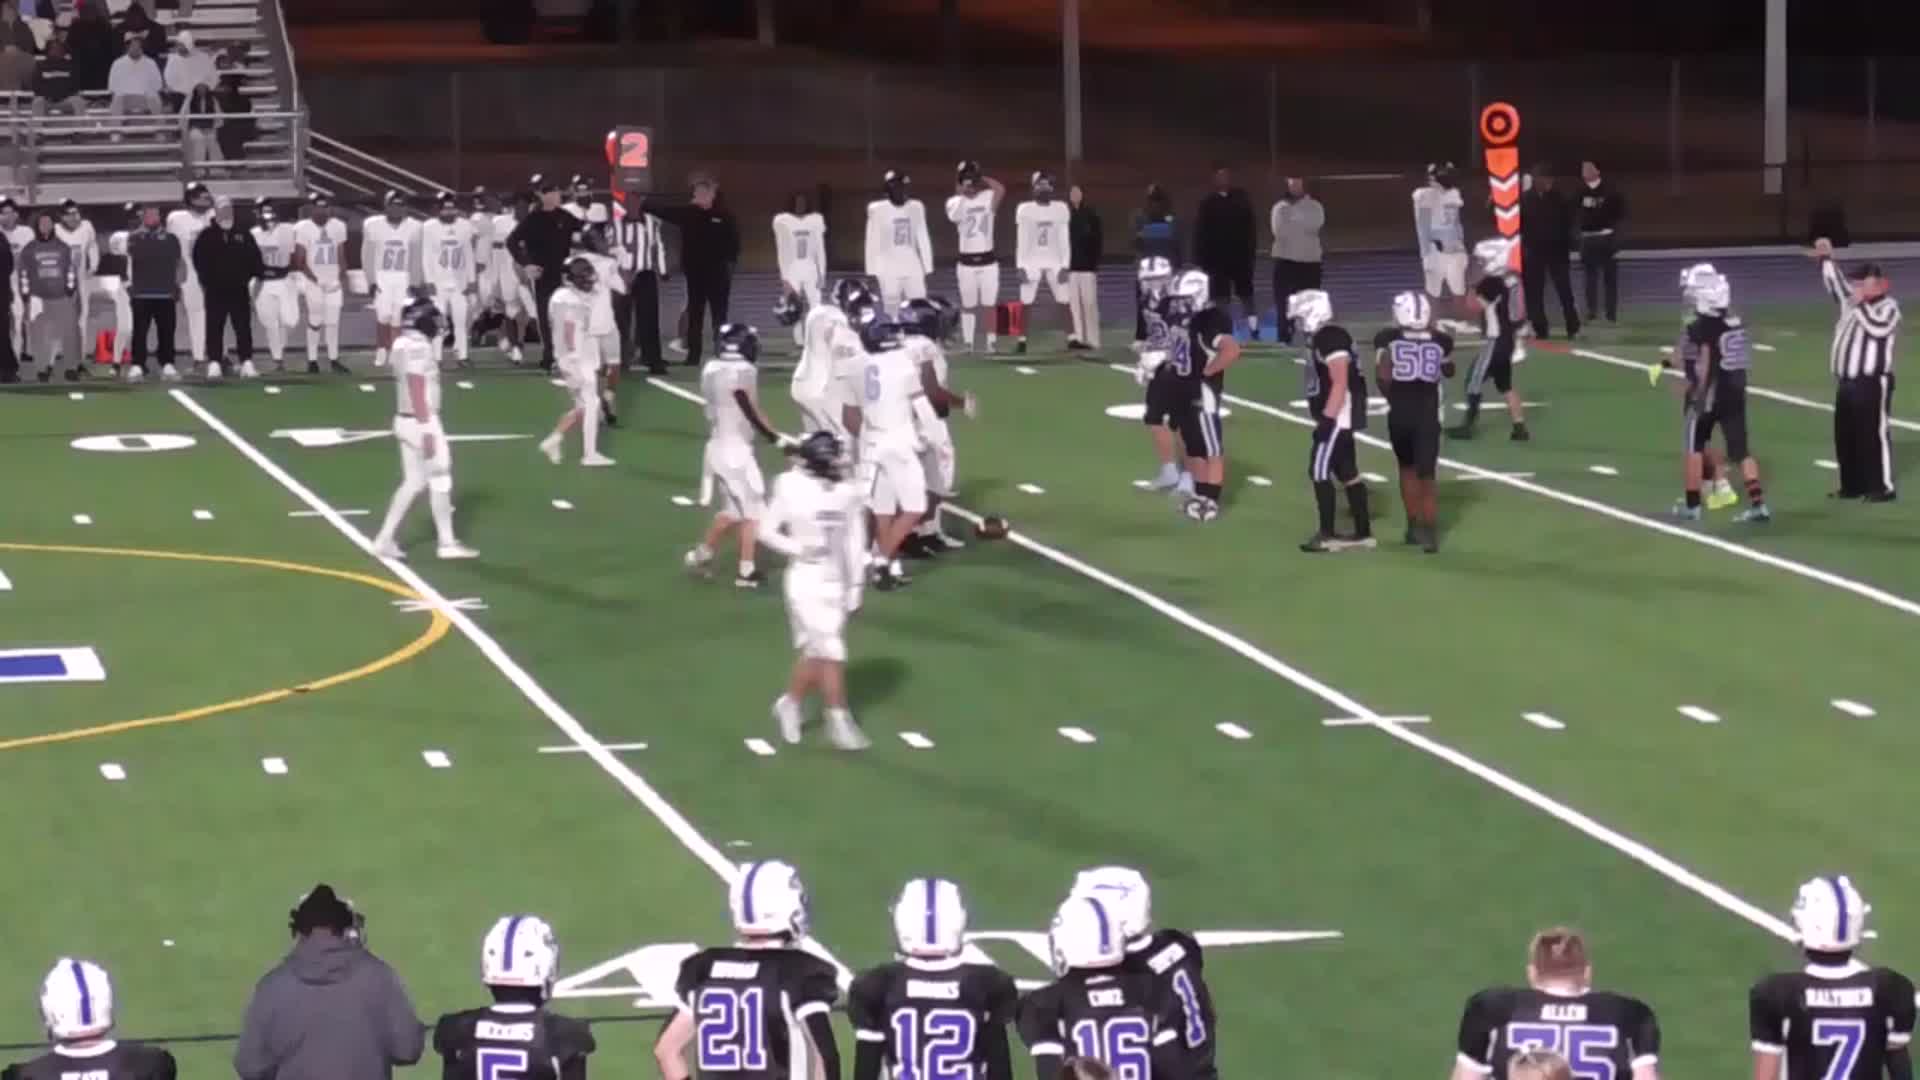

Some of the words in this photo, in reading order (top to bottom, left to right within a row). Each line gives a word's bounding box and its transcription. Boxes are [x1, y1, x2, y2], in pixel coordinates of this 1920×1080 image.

[620, 132, 648, 167] 2
[1390, 339, 1443, 382] 58
[698, 986, 767, 1071] 21
[1172, 968, 1207, 1049] 1
[891, 1007, 978, 1080] 12
[1071, 1016, 1152, 1080] 16
[1812, 1018, 1867, 1080] 7
